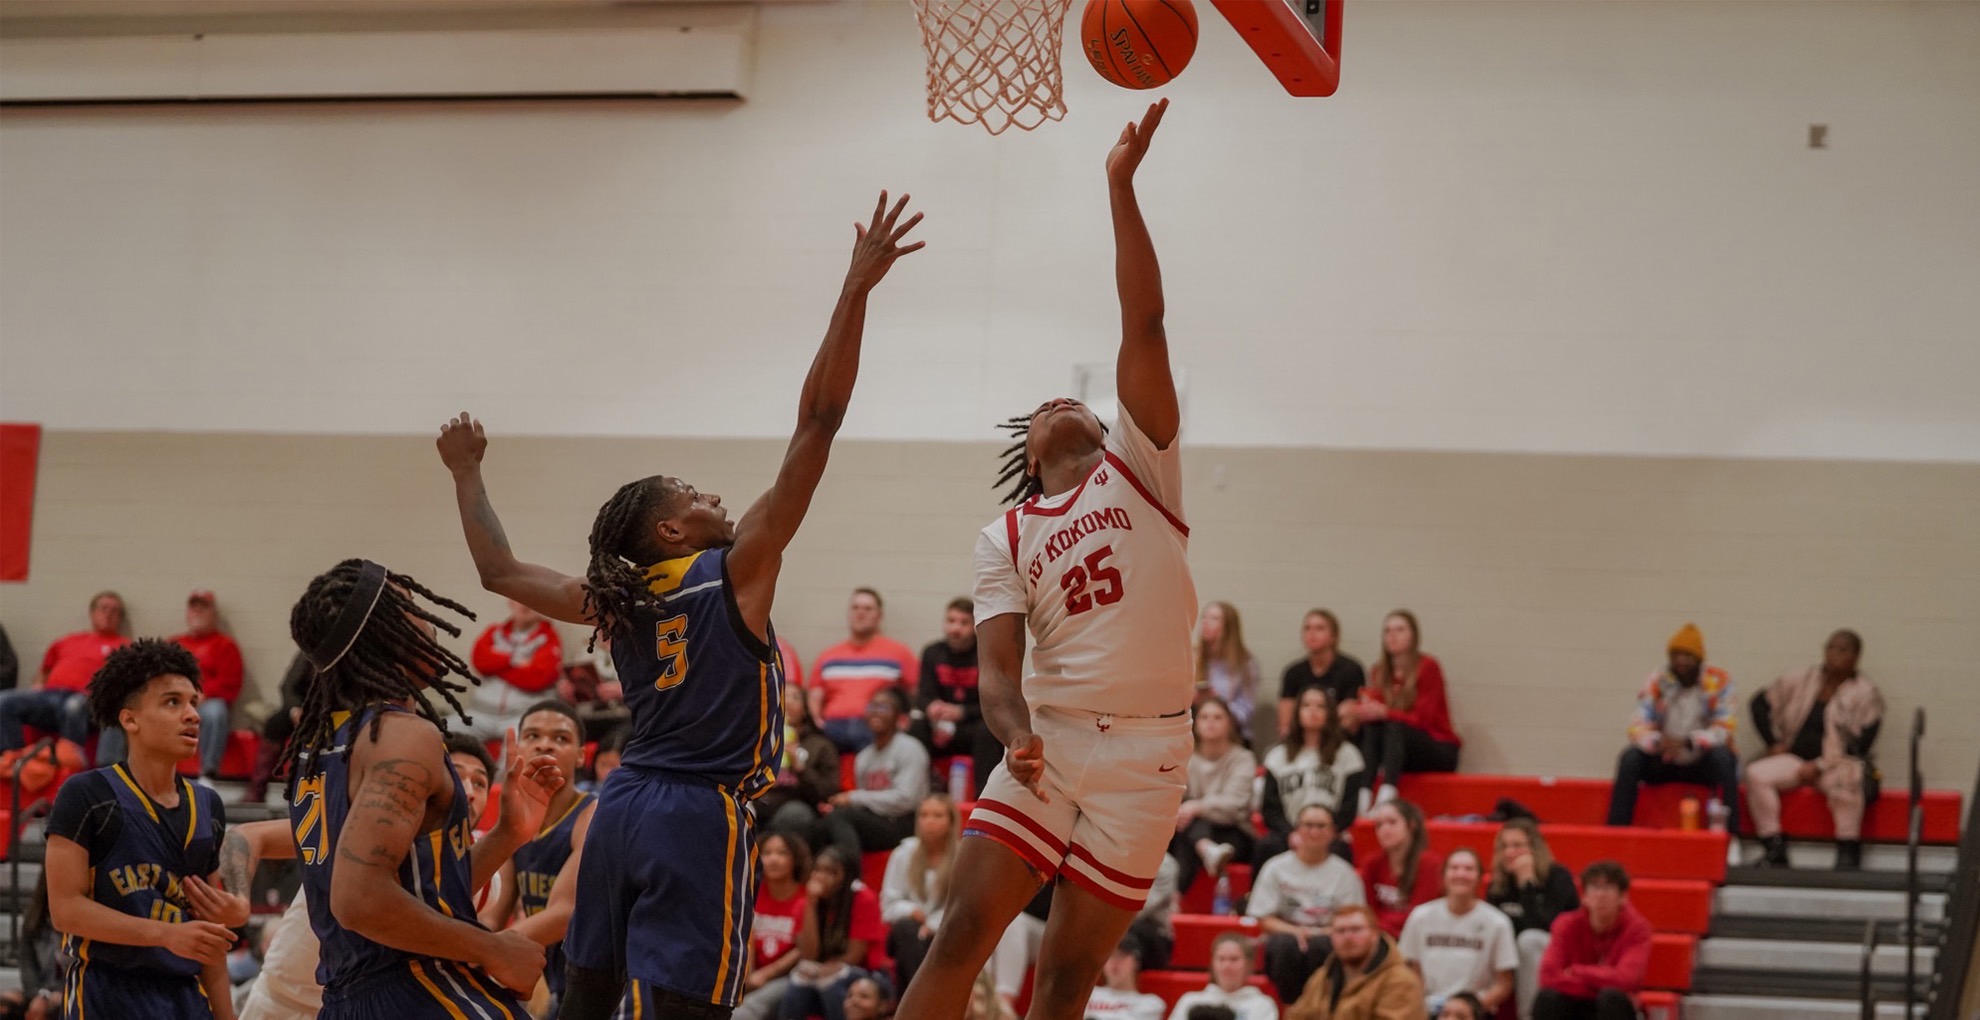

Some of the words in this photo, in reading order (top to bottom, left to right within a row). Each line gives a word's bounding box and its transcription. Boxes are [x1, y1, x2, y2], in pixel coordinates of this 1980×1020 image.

[1044, 507, 1133, 563] KOKOMO
[1060, 544, 1124, 616] 25
[655, 613, 689, 691] 5
[294, 771, 329, 865] 21
[109, 863, 161, 897] EAST
